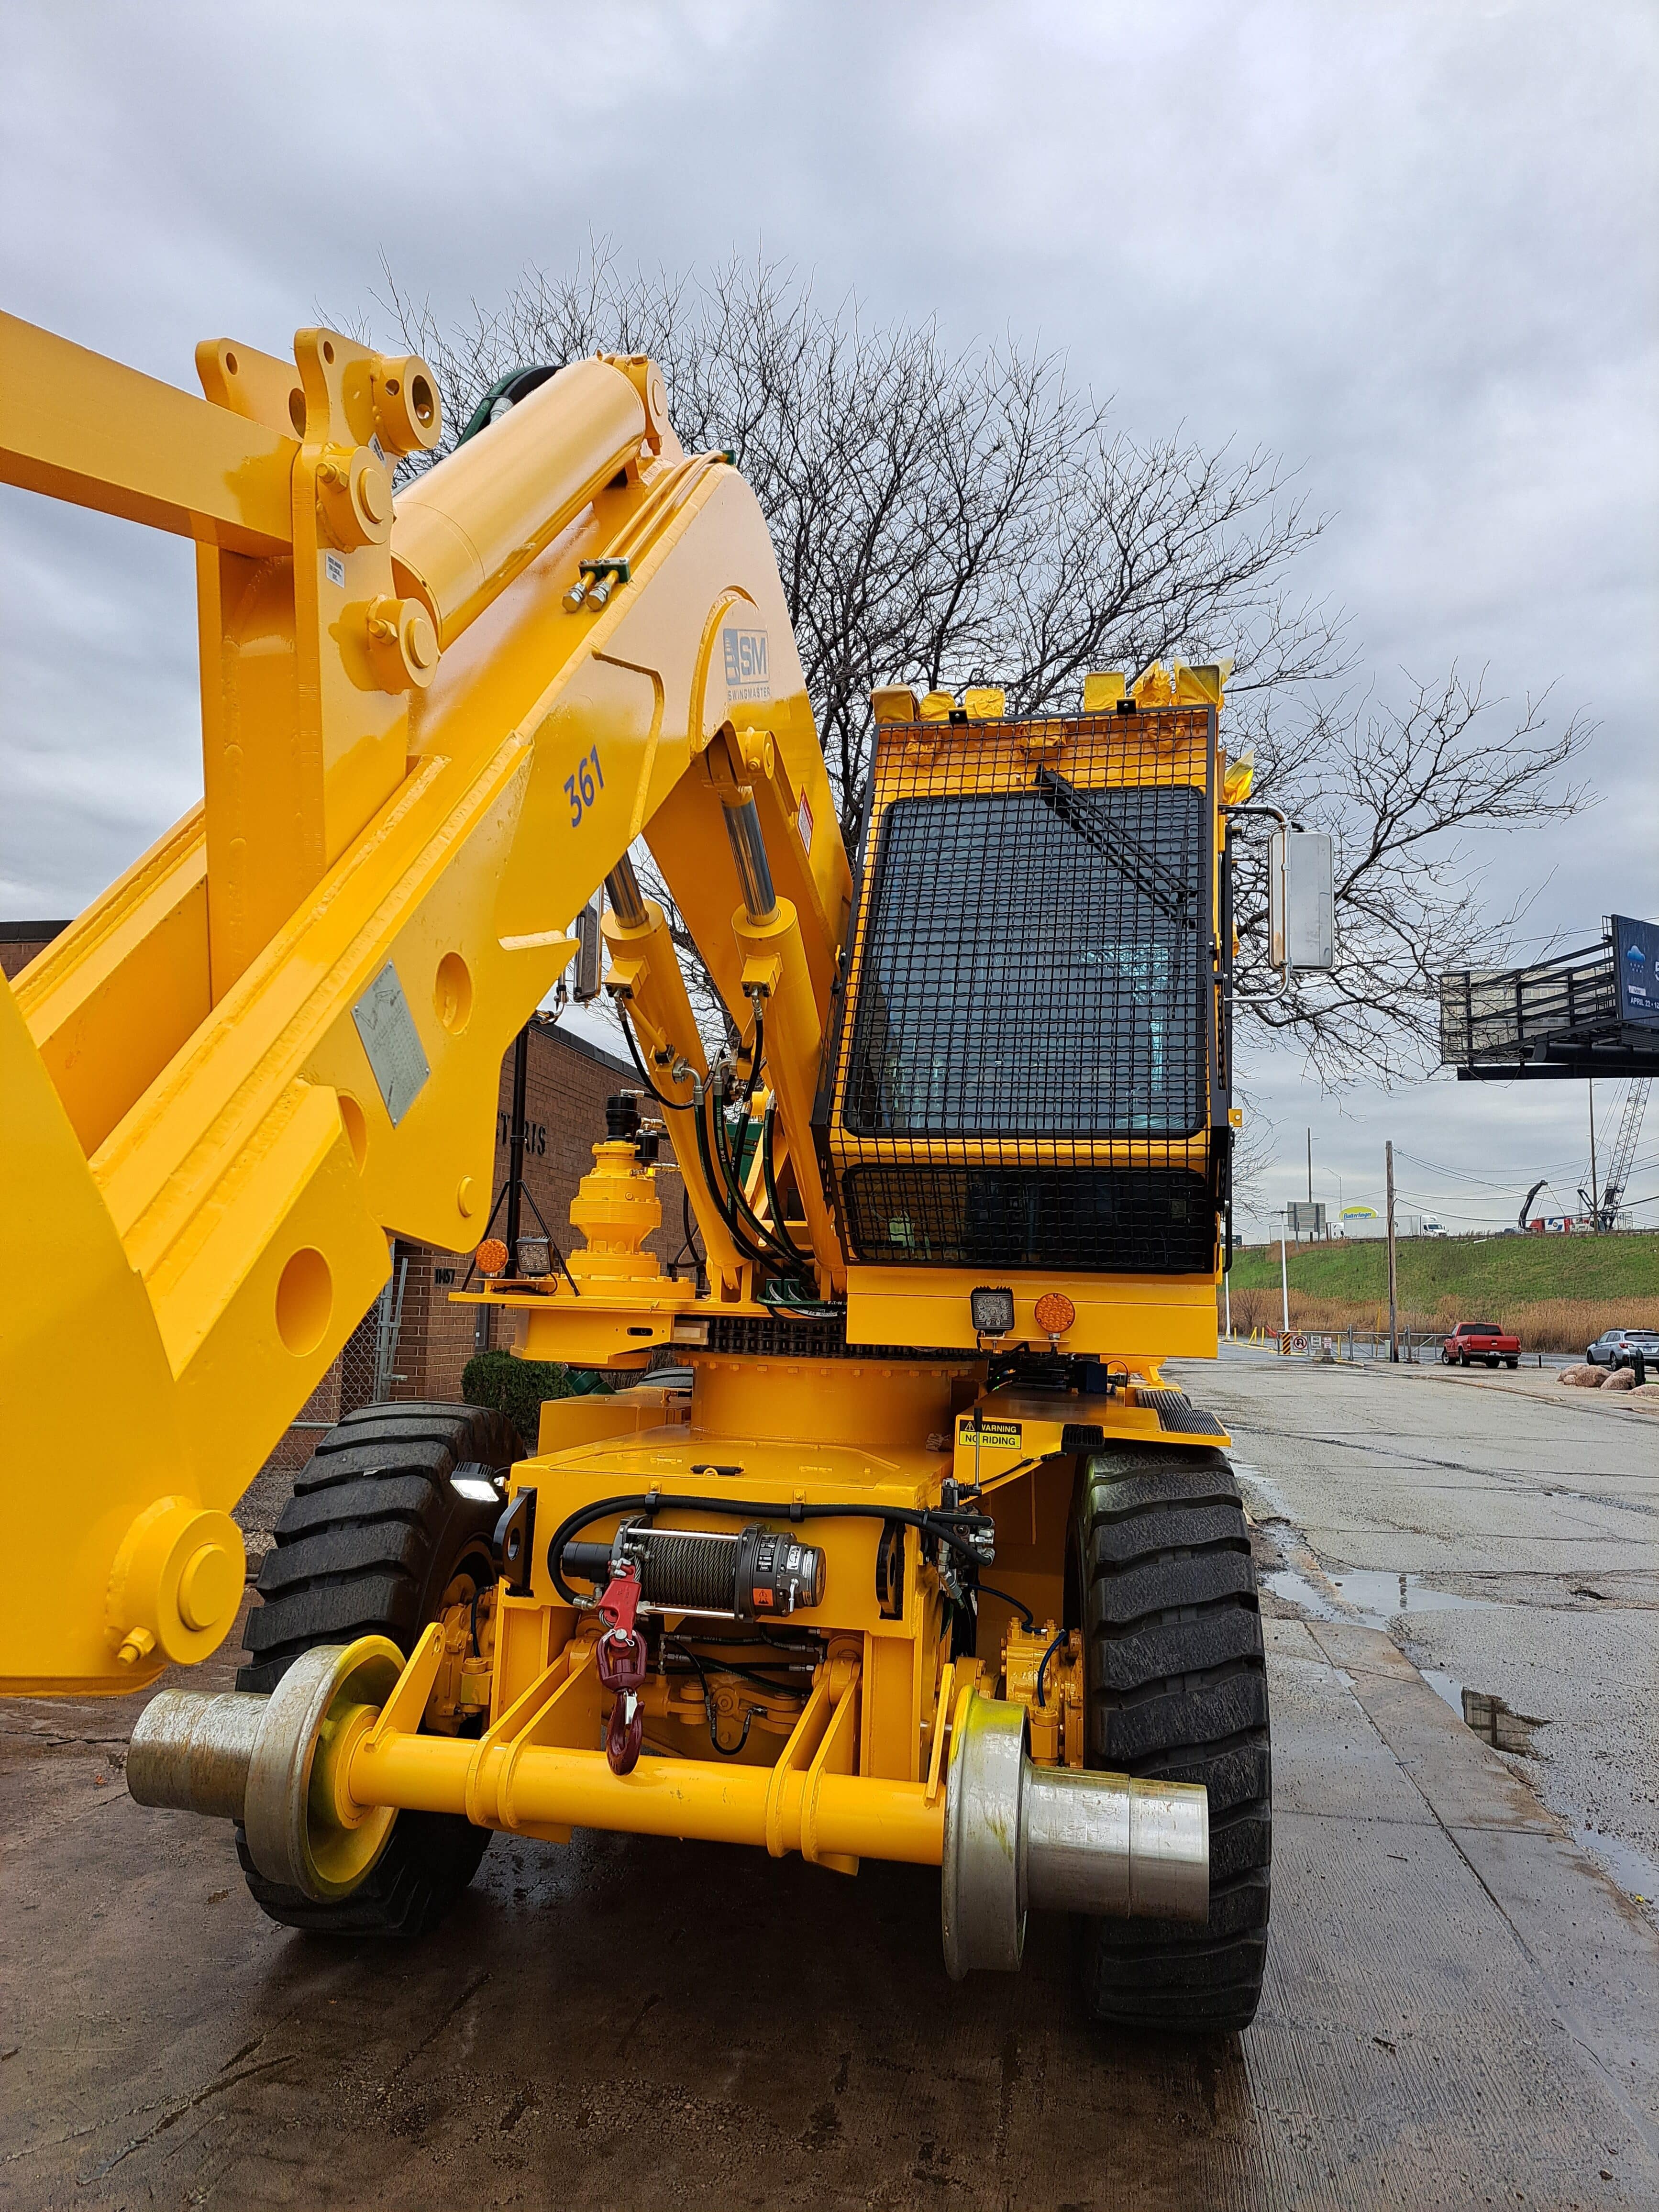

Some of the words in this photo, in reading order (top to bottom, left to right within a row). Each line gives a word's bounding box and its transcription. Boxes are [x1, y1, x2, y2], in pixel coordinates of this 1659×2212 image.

[740, 637, 767, 675] SM
[728, 687, 770, 701] SWINGMASTER
[564, 744, 604, 828] 361
[1630, 996, 1644, 1006] APRIL
[1645, 999, 1650, 1007] 22
[982, 1436, 1015, 1445] RIDING
